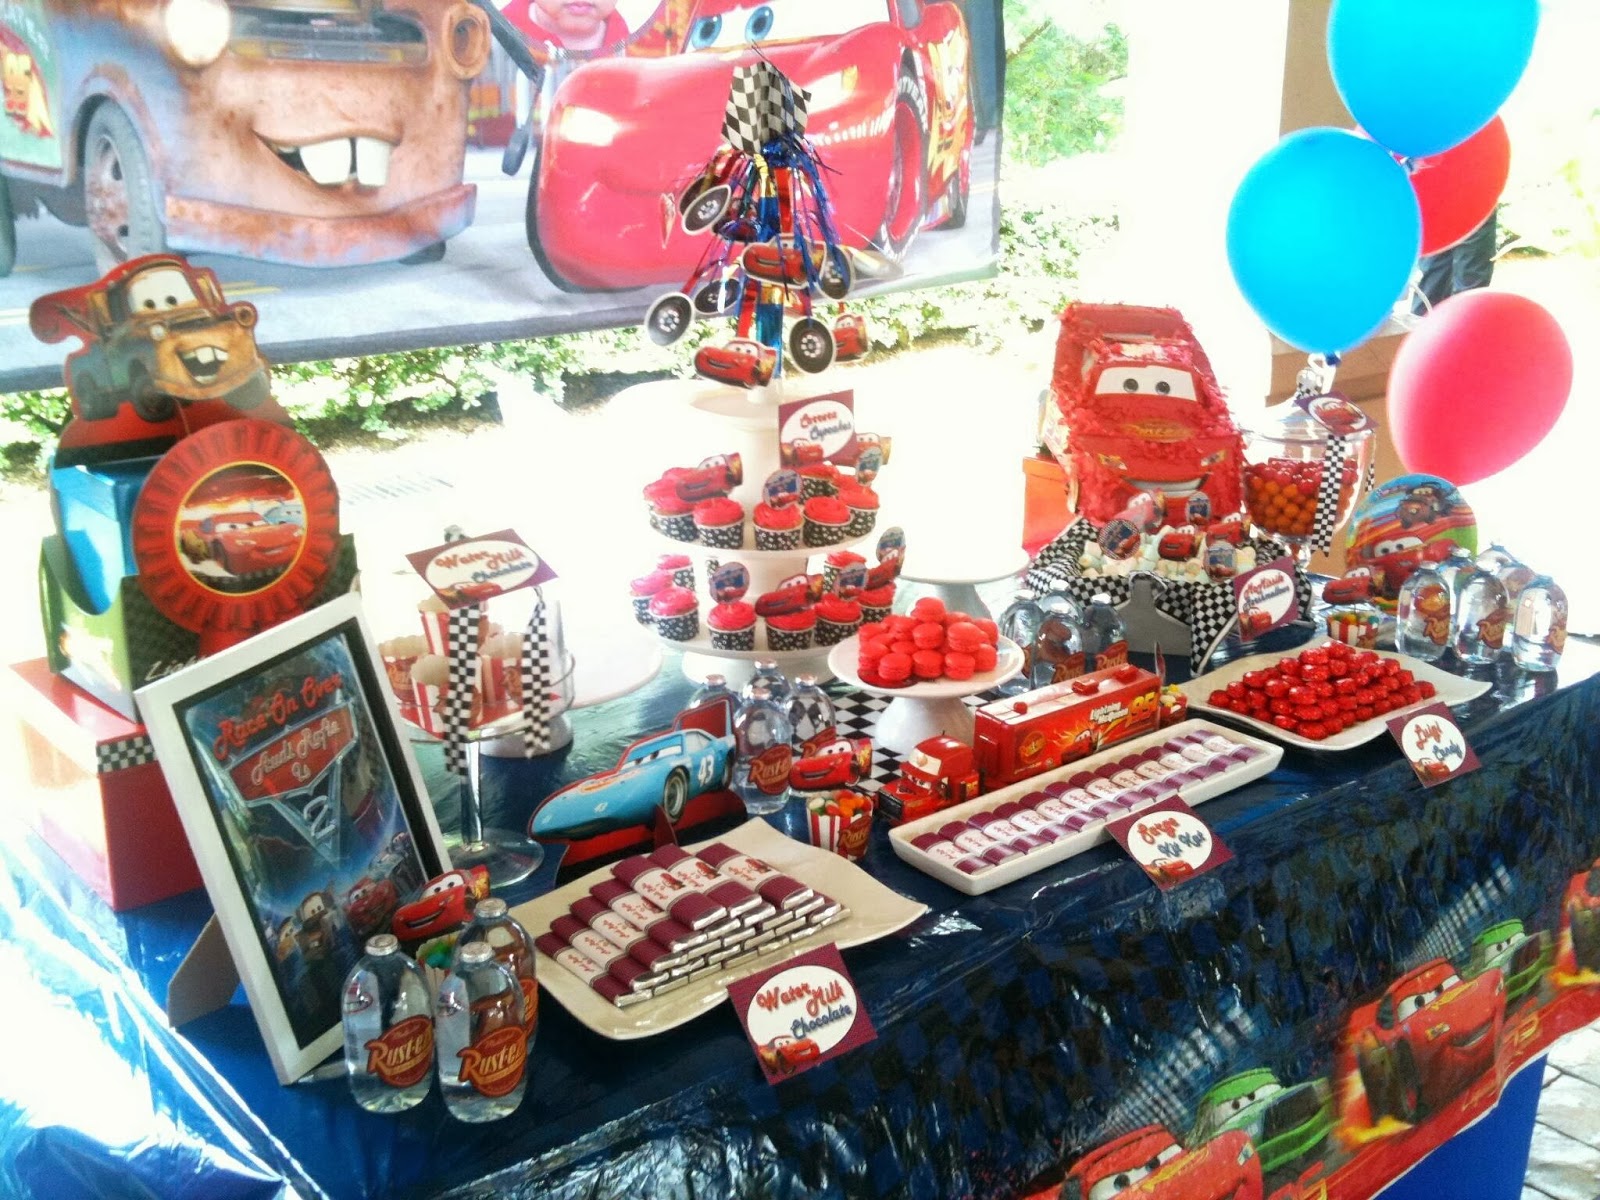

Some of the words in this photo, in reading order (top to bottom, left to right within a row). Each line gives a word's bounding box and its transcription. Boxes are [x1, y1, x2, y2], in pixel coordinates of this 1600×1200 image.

[698, 754, 715, 788] 43
[303, 794, 337, 840] 2
[755, 982, 812, 1012] Water
[806, 979, 846, 1018] Milk
[790, 1003, 853, 1040] Chocolate
